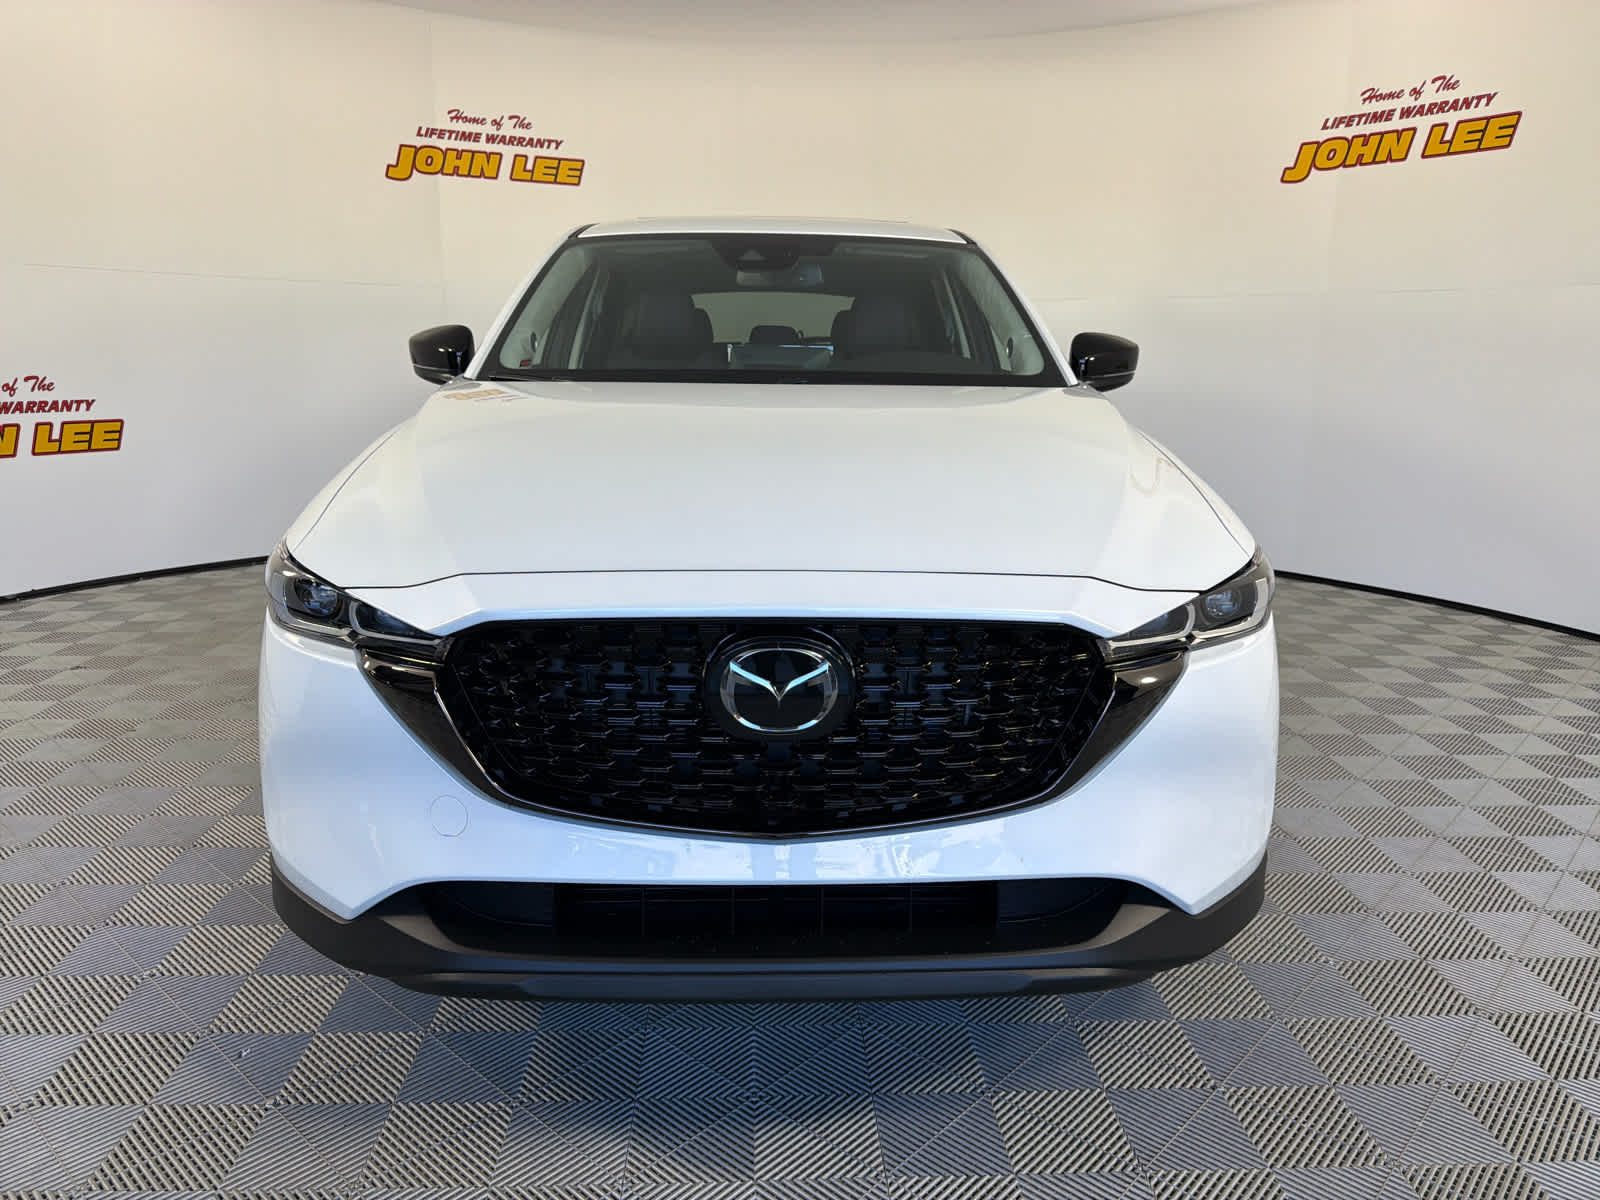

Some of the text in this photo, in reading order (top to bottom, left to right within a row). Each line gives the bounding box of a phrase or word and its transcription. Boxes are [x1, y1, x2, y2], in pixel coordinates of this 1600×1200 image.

[1360, 74, 1460, 104] Home of The
[447, 108, 532, 131] Home of The
[1321, 92, 1498, 130] LIFETIME WARRANTY
[416, 126, 563, 150] LIFETIME WARRANTY
[1280, 111, 1522, 184] JOHN LEE
[385, 143, 585, 186] JOHN LEE
[1, 375, 55, 397] of The
[31, 418, 124, 456] LEE
